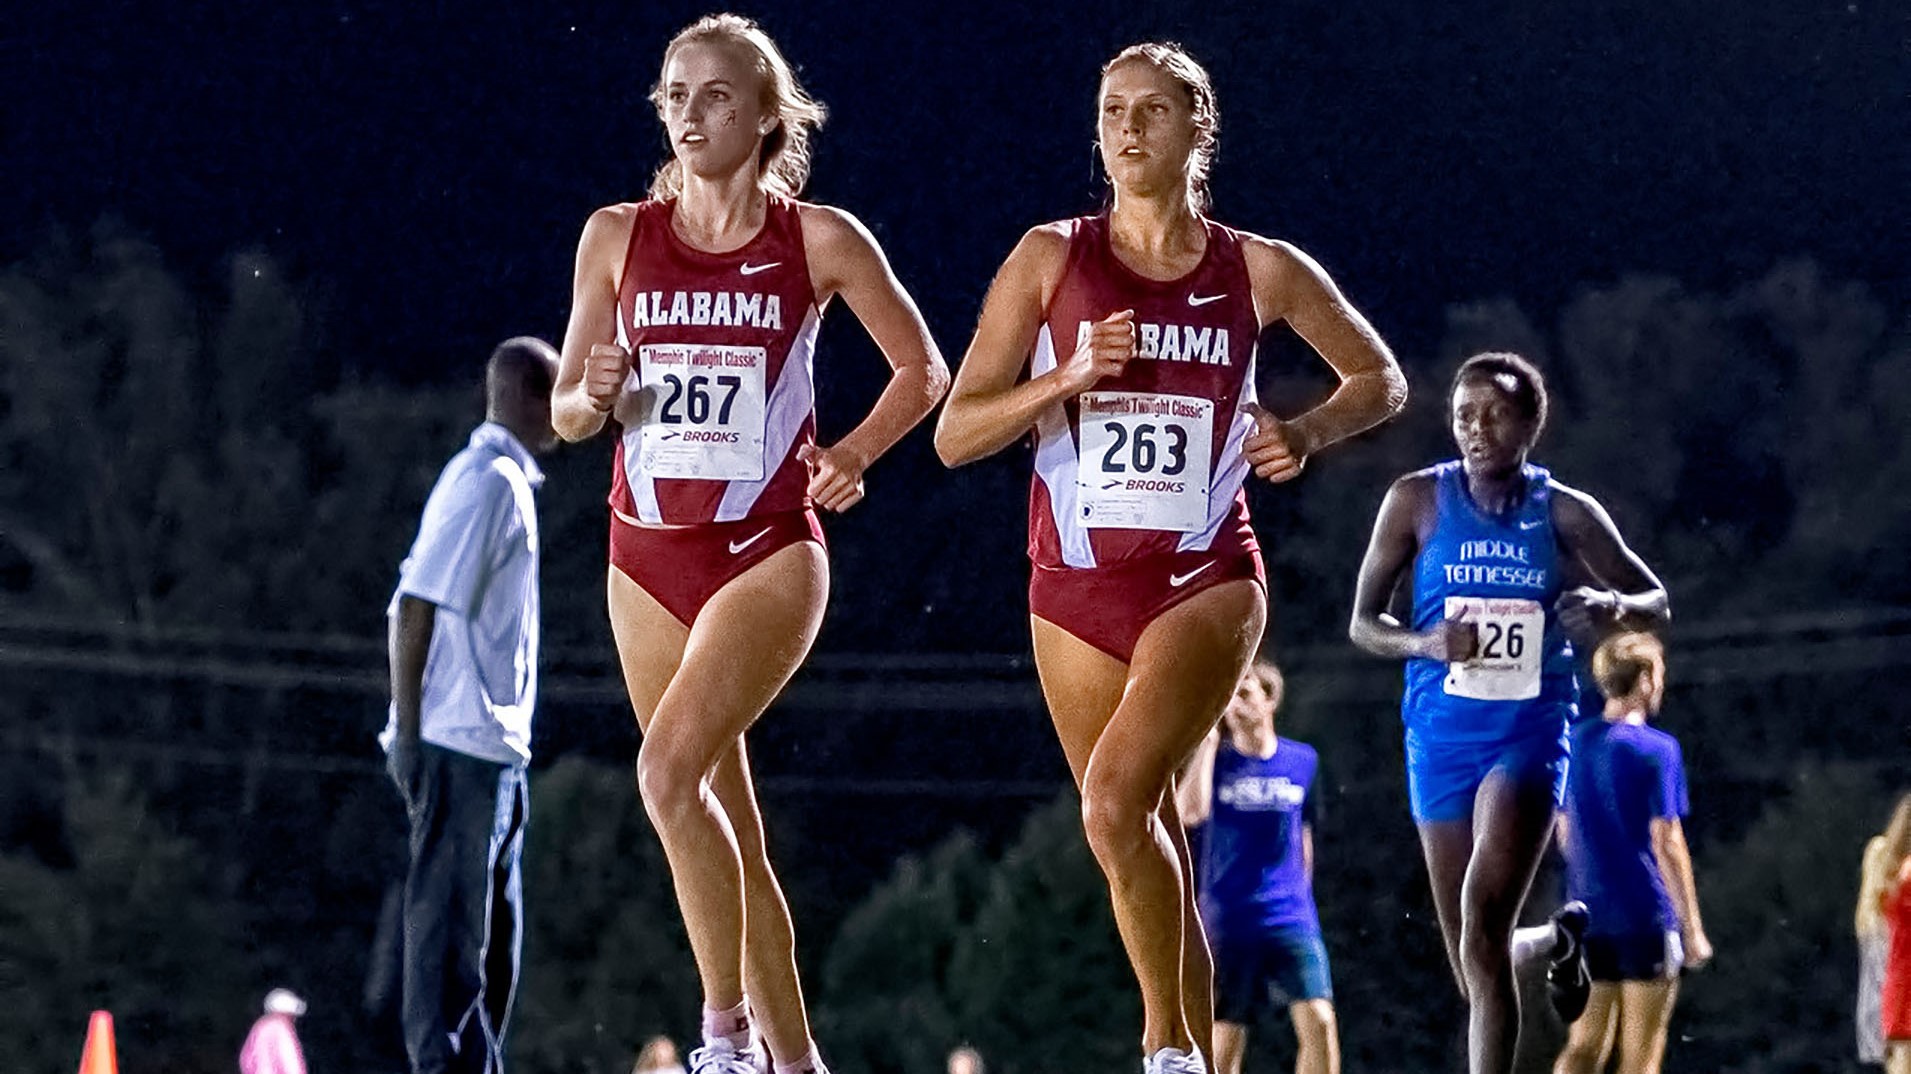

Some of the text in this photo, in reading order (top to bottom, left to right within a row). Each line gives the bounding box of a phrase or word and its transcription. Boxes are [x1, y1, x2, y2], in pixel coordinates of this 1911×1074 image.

[633, 291, 782, 330] ALABAMA
[1076, 320, 1231, 366] ABAMA
[649, 348, 757, 369] Memphis Twilight Classic
[660, 373, 741, 425] 267
[1090, 395, 1203, 419] Memphis Twilight Classic
[683, 431, 740, 443] BROOKS
[1101, 421, 1188, 475] 263
[1125, 480, 1185, 494] BROOKS
[1460, 539, 1529, 564] MIDDLE
[1443, 564, 1546, 589] TENNESSEE
